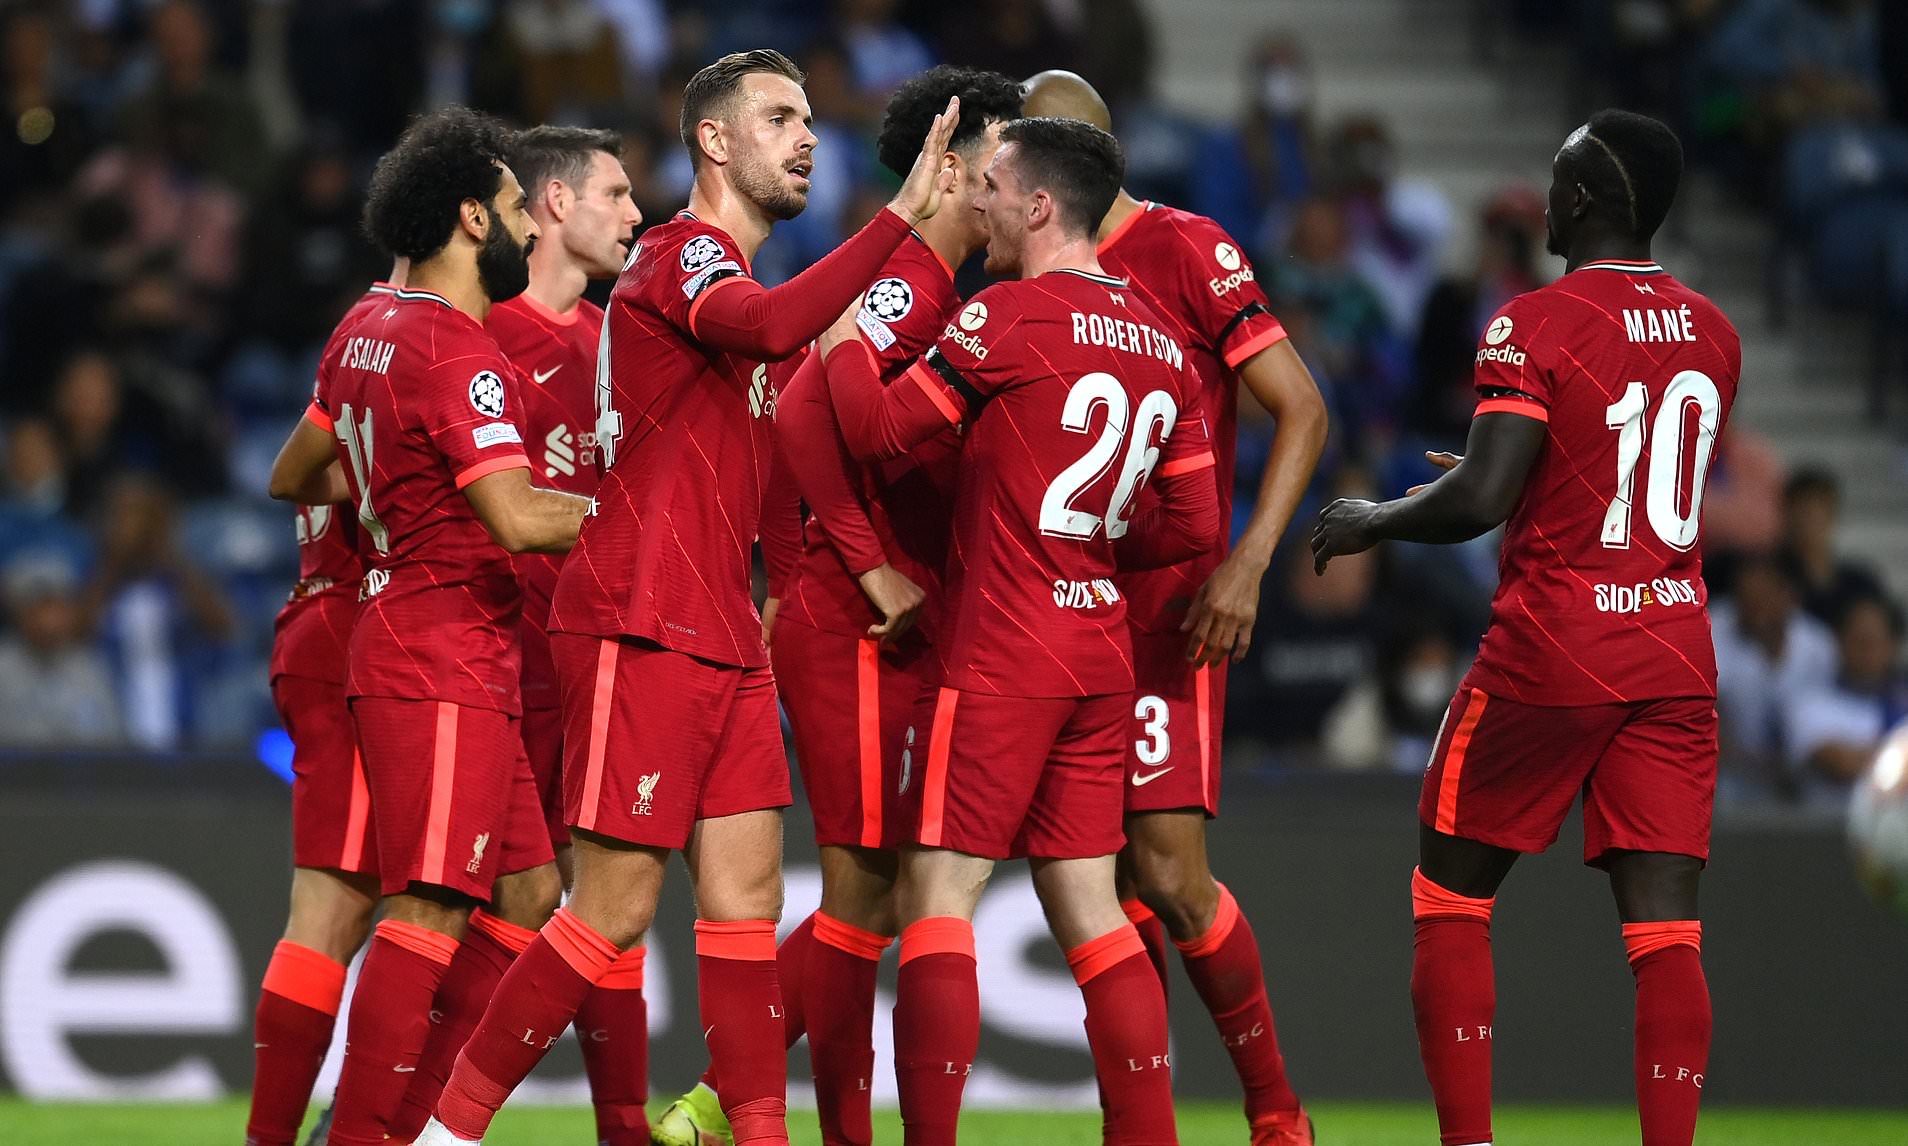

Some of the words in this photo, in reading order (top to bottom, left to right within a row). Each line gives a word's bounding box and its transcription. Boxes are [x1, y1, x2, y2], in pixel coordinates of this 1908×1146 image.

[1071, 312, 1184, 372] ROBERTSON
[1623, 304, 1697, 343] MANÉ
[333, 403, 391, 557] 11
[1039, 372, 1178, 544] 26
[1600, 370, 1721, 552] 10
[1053, 580, 1097, 609] SIDE
[1594, 583, 1647, 613] SIDE
[1652, 577, 1700, 607] SIDE
